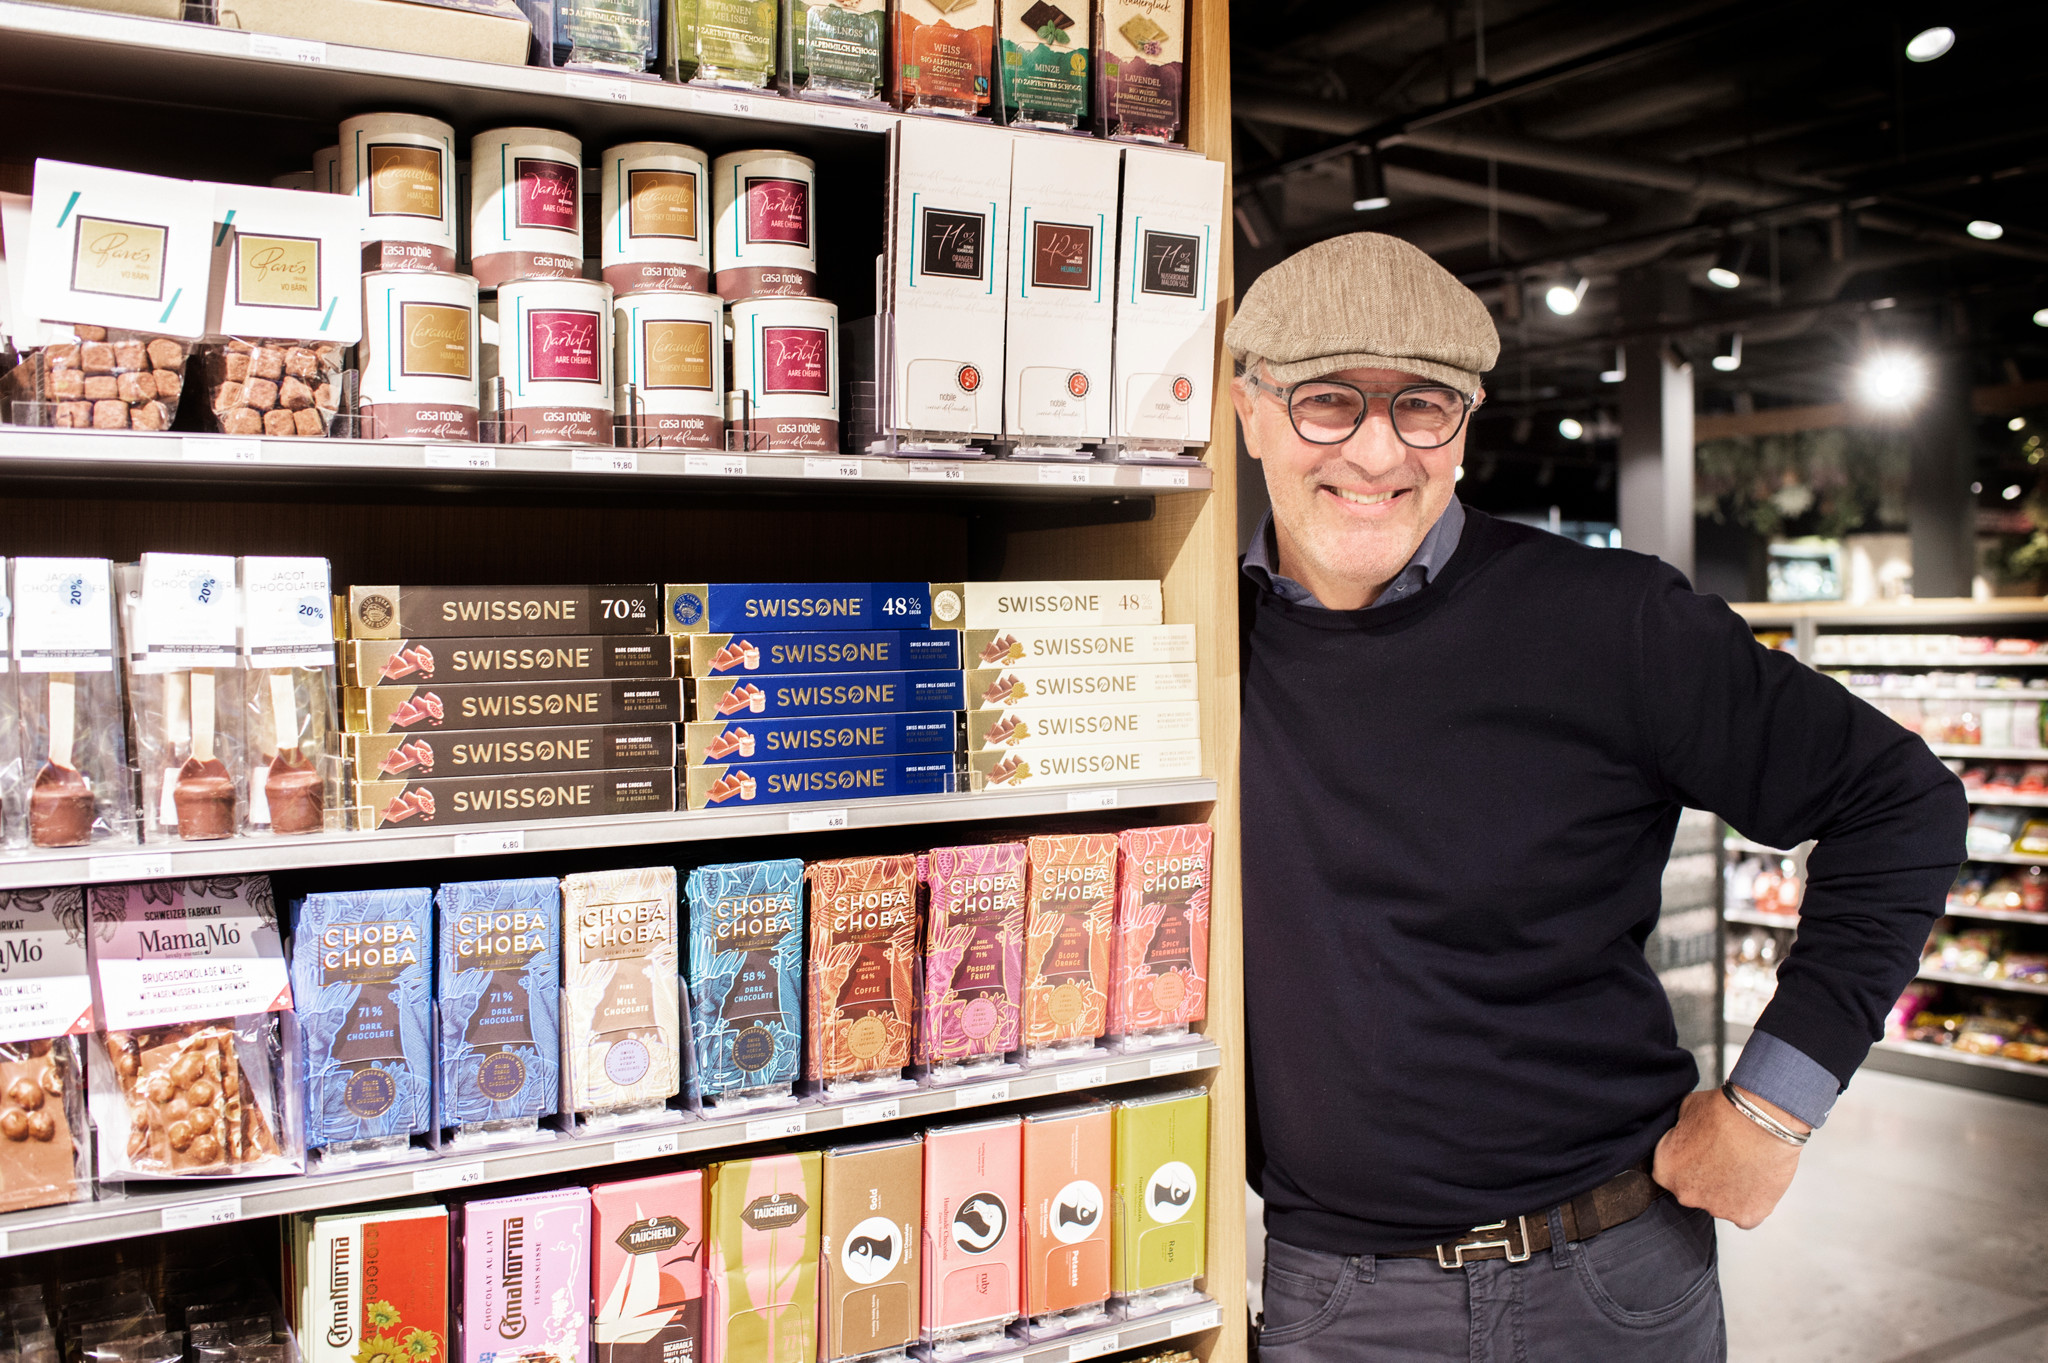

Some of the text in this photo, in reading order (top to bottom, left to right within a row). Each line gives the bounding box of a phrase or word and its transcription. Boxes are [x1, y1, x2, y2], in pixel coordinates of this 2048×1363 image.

[575, 8, 621, 23] ALPENMILCH
[712, 11, 748, 25] MELISSE
[810, 41, 850, 53] ALPENMILCH
[934, 42, 961, 55] WEISS
[920, 55, 972, 70] BIO ALPENMILCH
[1034, 63, 1060, 74] MINZE
[1125, 74, 1161, 87] LAVENDEL
[524, 171, 575, 206] Tartufi
[543, 204, 556, 213] AARE
[754, 187, 804, 220] Tartufi
[383, 245, 432, 258] casa nobile
[534, 256, 574, 270] casa nobile
[642, 266, 687, 278] casa nobile
[281, 283, 290, 291] VO
[761, 273, 803, 285] casa nobile
[536, 320, 594, 357] Tartufi
[555, 355, 570, 364] AARE
[770, 336, 823, 370] Tartufi
[788, 369, 801, 377] AARE
[939, 393, 956, 402] nobile
[1050, 400, 1067, 408] nobile
[1155, 403, 1171, 411] nobile
[416, 410, 464, 423] casa nobile
[543, 411, 591, 423] casa nobile
[659, 418, 704, 431] casa nobile
[777, 422, 820, 434] casa nobile
[272, 571, 305, 580] JACOT
[70, 579, 83, 605] 20%
[198, 577, 217, 604] 20%
[251, 582, 326, 592] CHOCOLATIER
[299, 604, 324, 619] 20%
[442, 598, 646, 621] SWISSONE 70%
[745, 597, 921, 617] SWISSONE 48%
[998, 596, 1099, 613] SWISSONE
[771, 643, 889, 664] SWISSONE
[1033, 637, 1135, 656] SWISSONE
[452, 648, 591, 671] SWISSONE
[1036, 675, 1136, 696] SWISSONE
[777, 684, 895, 707] SWISSONE
[462, 692, 599, 718] SWISSONE
[1038, 715, 1138, 736] SWISSONE
[766, 727, 885, 750] SWISSONE
[452, 739, 591, 765] SWISSONE
[1040, 754, 1140, 776] SWISSONE
[768, 769, 885, 793] SWISSONE
[453, 784, 592, 812] SWISSONE
[1043, 867, 1107, 884] CHOBA
[1144, 858, 1204, 875] CHOBA
[950, 876, 1018, 895] CHOBA
[1042, 884, 1106, 901] CHOBA
[1143, 875, 1204, 893] CHOBA
[716, 896, 793, 918] CHOBA
[834, 892, 908, 914] CHOBA
[950, 894, 1018, 914] CHOBA
[144, 906, 222, 921] SCHWEIZER FABRIKAT
[583, 902, 667, 928] CHOBA
[834, 911, 908, 932] CHOBA
[458, 913, 546, 935] CHOBA
[716, 917, 793, 938] CHOBA
[136, 923, 241, 961] MamaMo
[324, 925, 417, 947] CHOBA
[583, 925, 667, 949] CHOBA
[458, 935, 546, 957] CHOBA
[324, 948, 417, 970] CHOBA
[142, 964, 242, 983] BRUCHSCHOKOLADE MILCH
[734, 992, 774, 1003] CHOCOLATE
[745, 985, 763, 994] DARK
[479, 1014, 524, 1026] CHOCOLATE
[491, 1007, 512, 1016] DARK
[347, 1029, 394, 1041] CHOCOLATE
[359, 1022, 382, 1031] DARK
[869, 1188, 878, 1210] Gold
[753, 1204, 797, 1220] TAUCHERLI
[630, 1226, 676, 1244] TAUCHERLI
[486, 1255, 493, 1270] AU
[534, 1242, 542, 1273] SUISSE
[979, 1273, 990, 1295] ruby
[484, 1273, 493, 1331] CHOCOLAT
